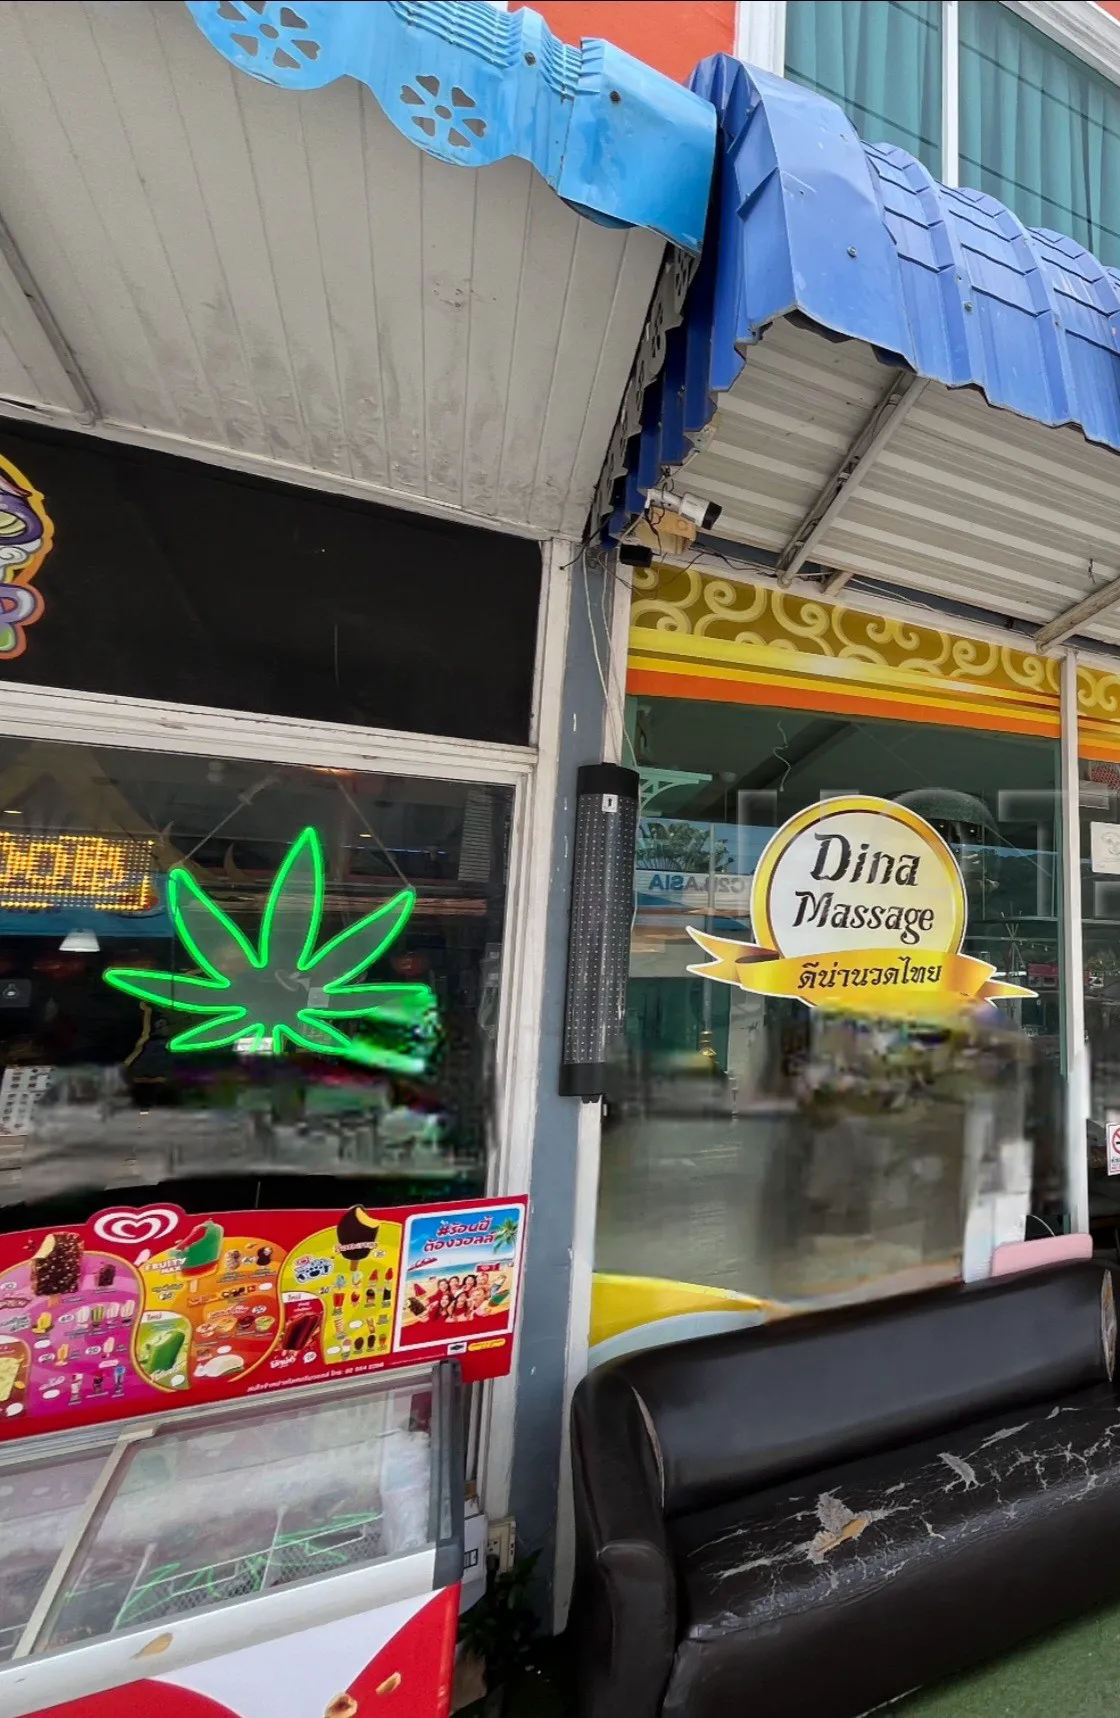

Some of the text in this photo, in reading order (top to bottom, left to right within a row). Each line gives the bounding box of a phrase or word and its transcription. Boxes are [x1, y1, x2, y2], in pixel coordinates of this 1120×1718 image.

[810, 832, 921, 887] Dina
[792, 890, 935, 945] Massage
[798, 956, 942, 990] ดีน่านวดไทย
[145, 1257, 187, 1271] FRUITY
